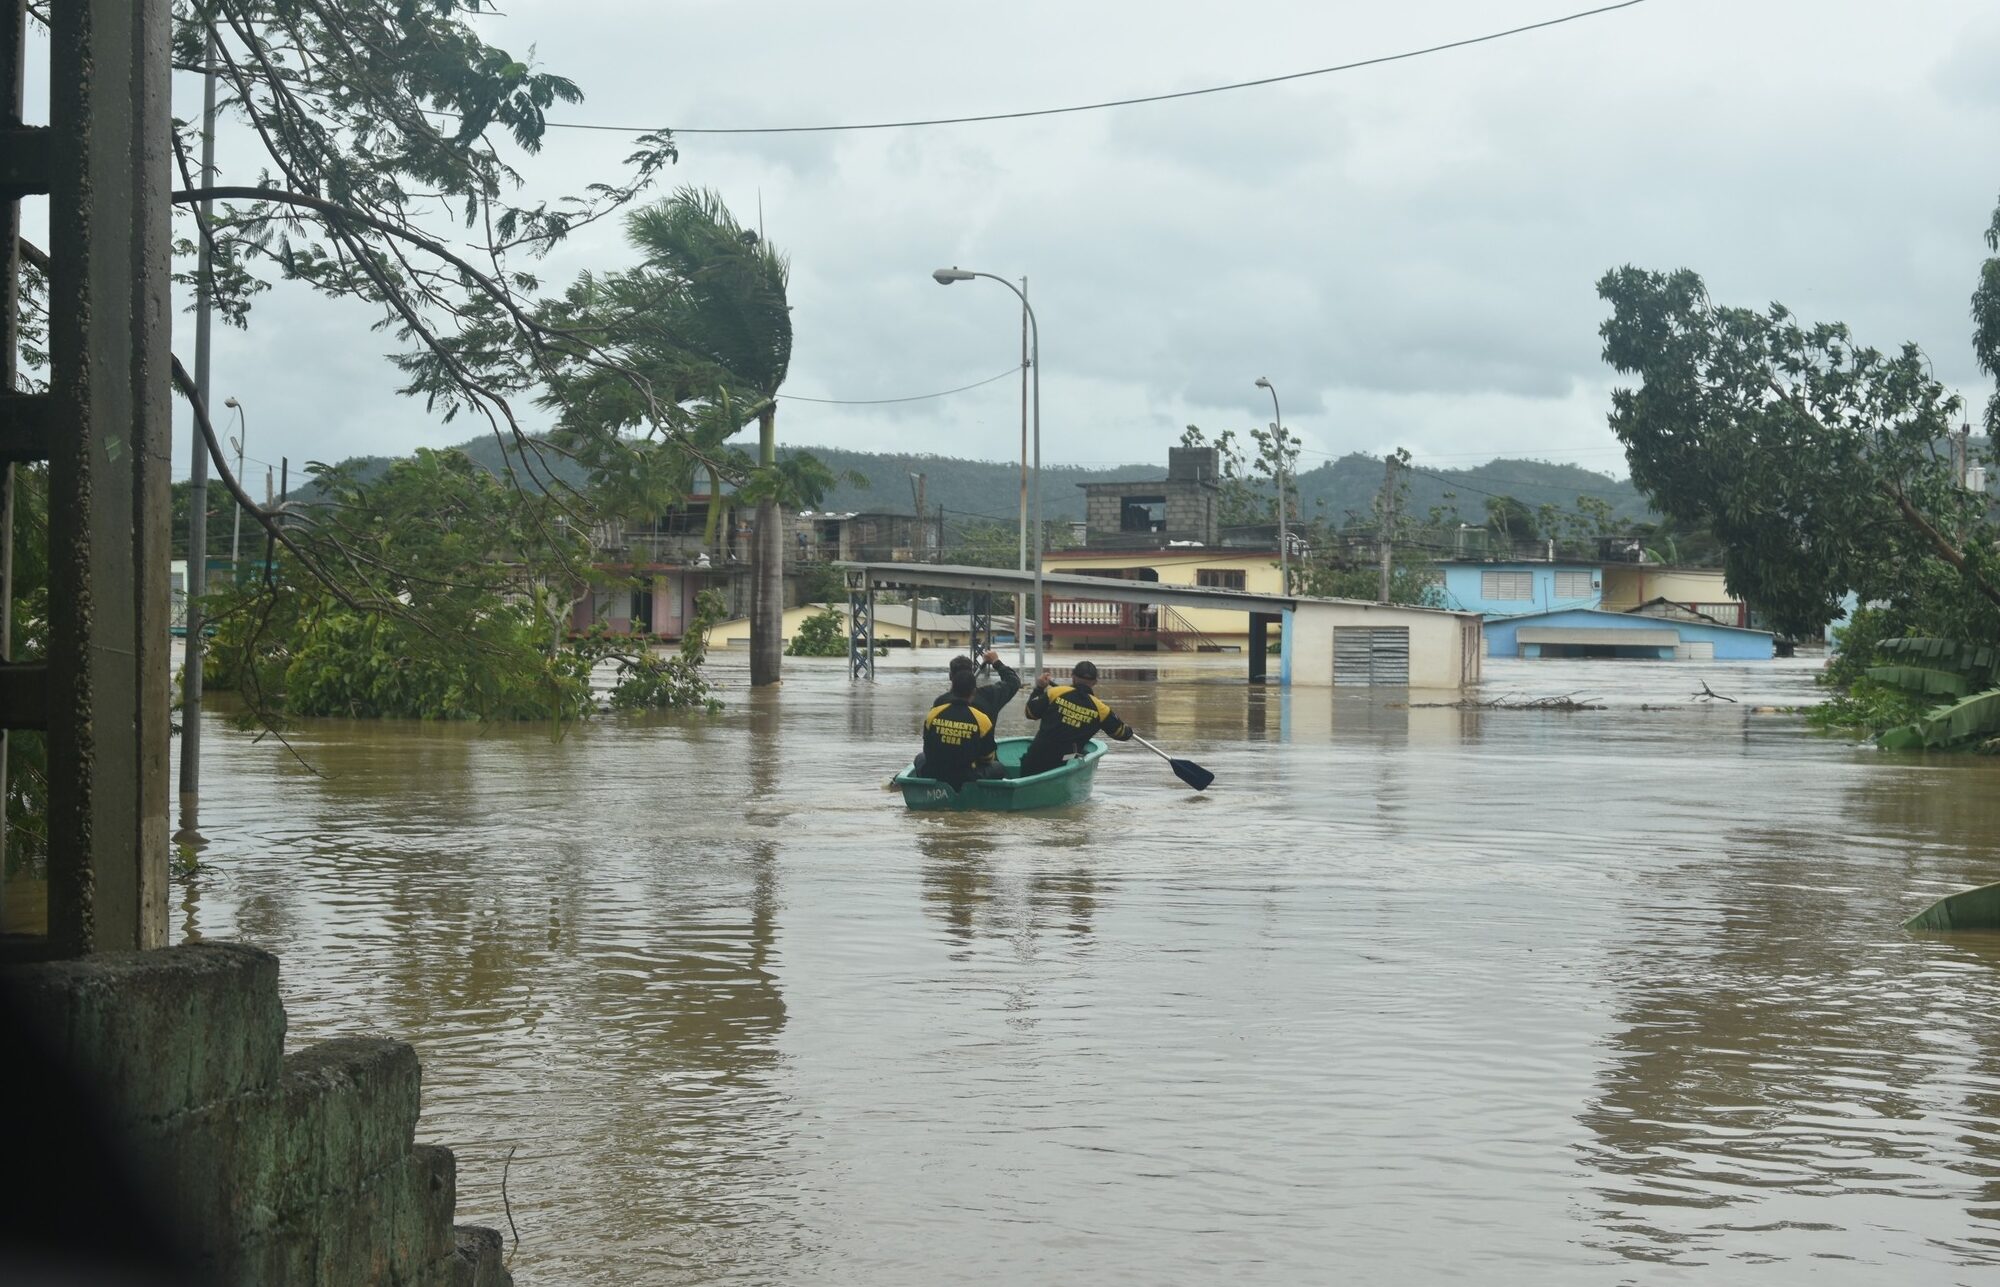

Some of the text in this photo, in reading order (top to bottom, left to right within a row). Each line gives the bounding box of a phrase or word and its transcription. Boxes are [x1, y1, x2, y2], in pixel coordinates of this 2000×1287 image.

[1055, 697, 1098, 718] SALVAMENTO
[1062, 707, 1093, 723] RESCATE
[932, 718, 978, 732] SALVAMENTO
[940, 727, 972, 739] RESCATE
[927, 789, 948, 801] MOA
